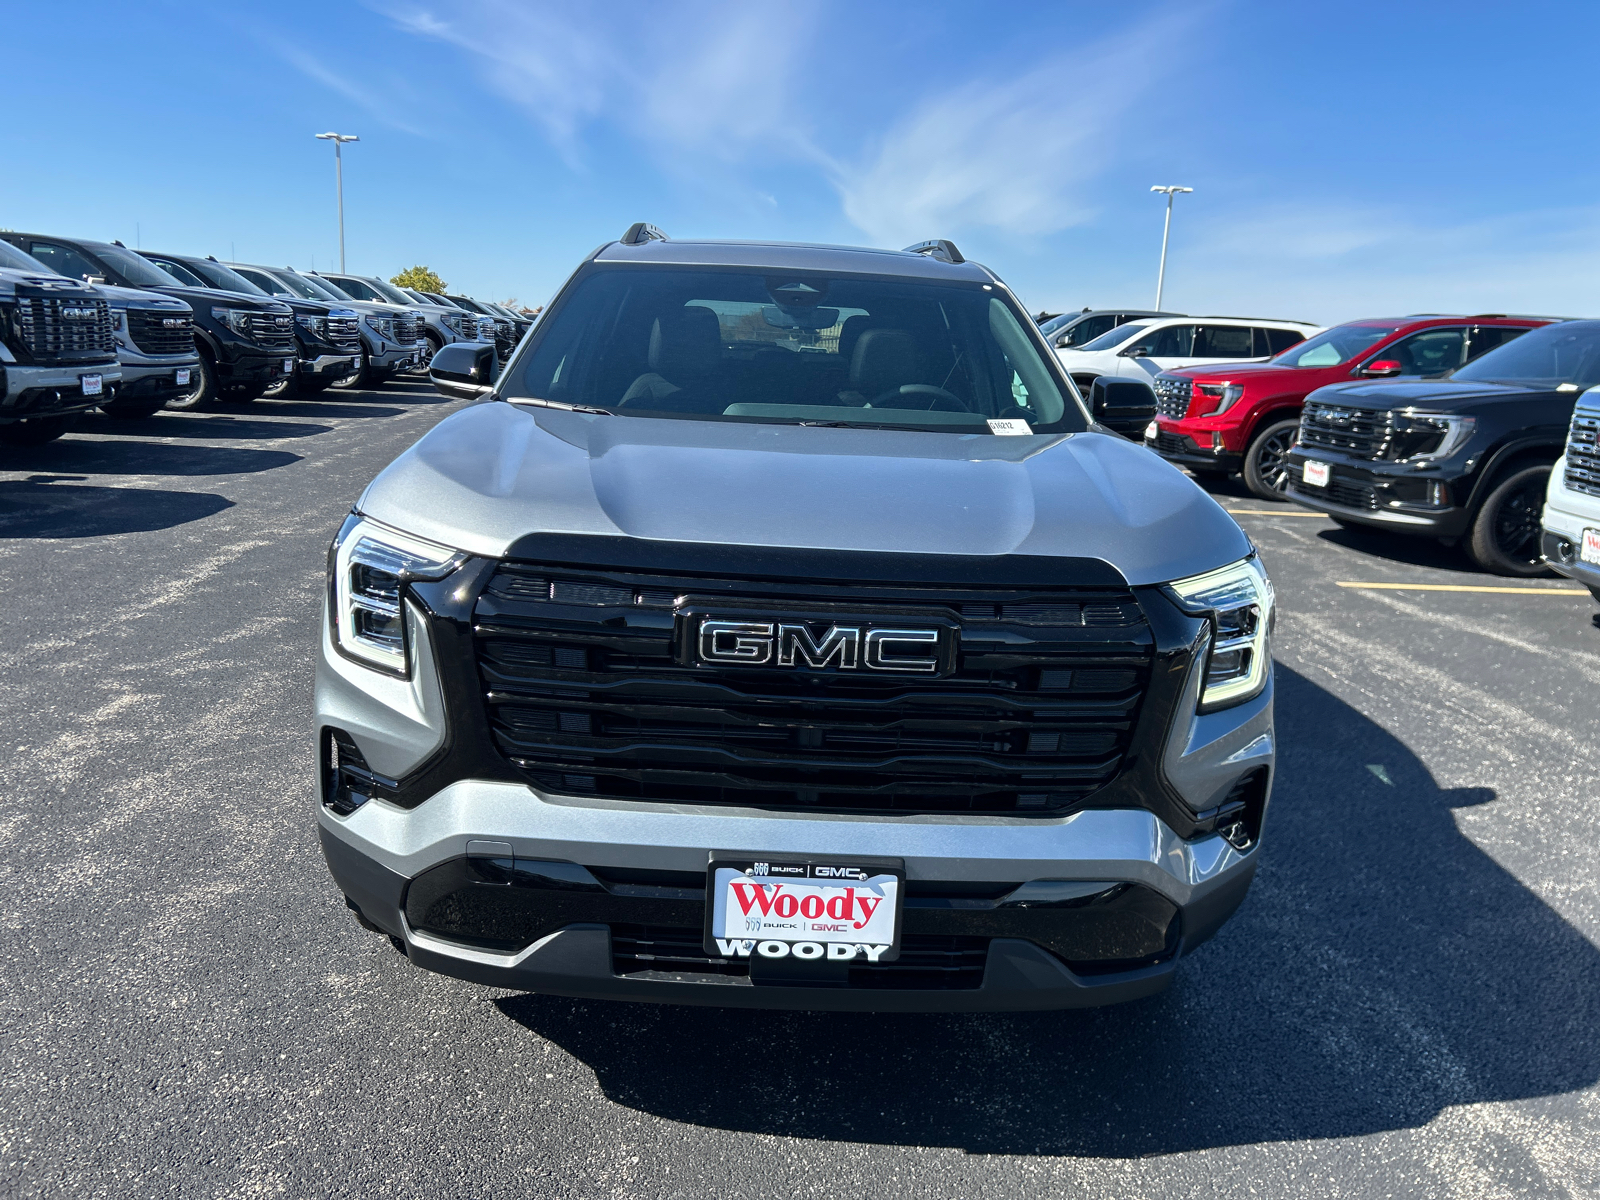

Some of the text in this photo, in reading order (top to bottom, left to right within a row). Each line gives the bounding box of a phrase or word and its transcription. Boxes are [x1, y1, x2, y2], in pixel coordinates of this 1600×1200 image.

[700, 620, 938, 672] GMC
[815, 866, 861, 878] GMC
[729, 882, 883, 930] Woody
[811, 923, 848, 933] GMC
[715, 938, 890, 962] WOODY
